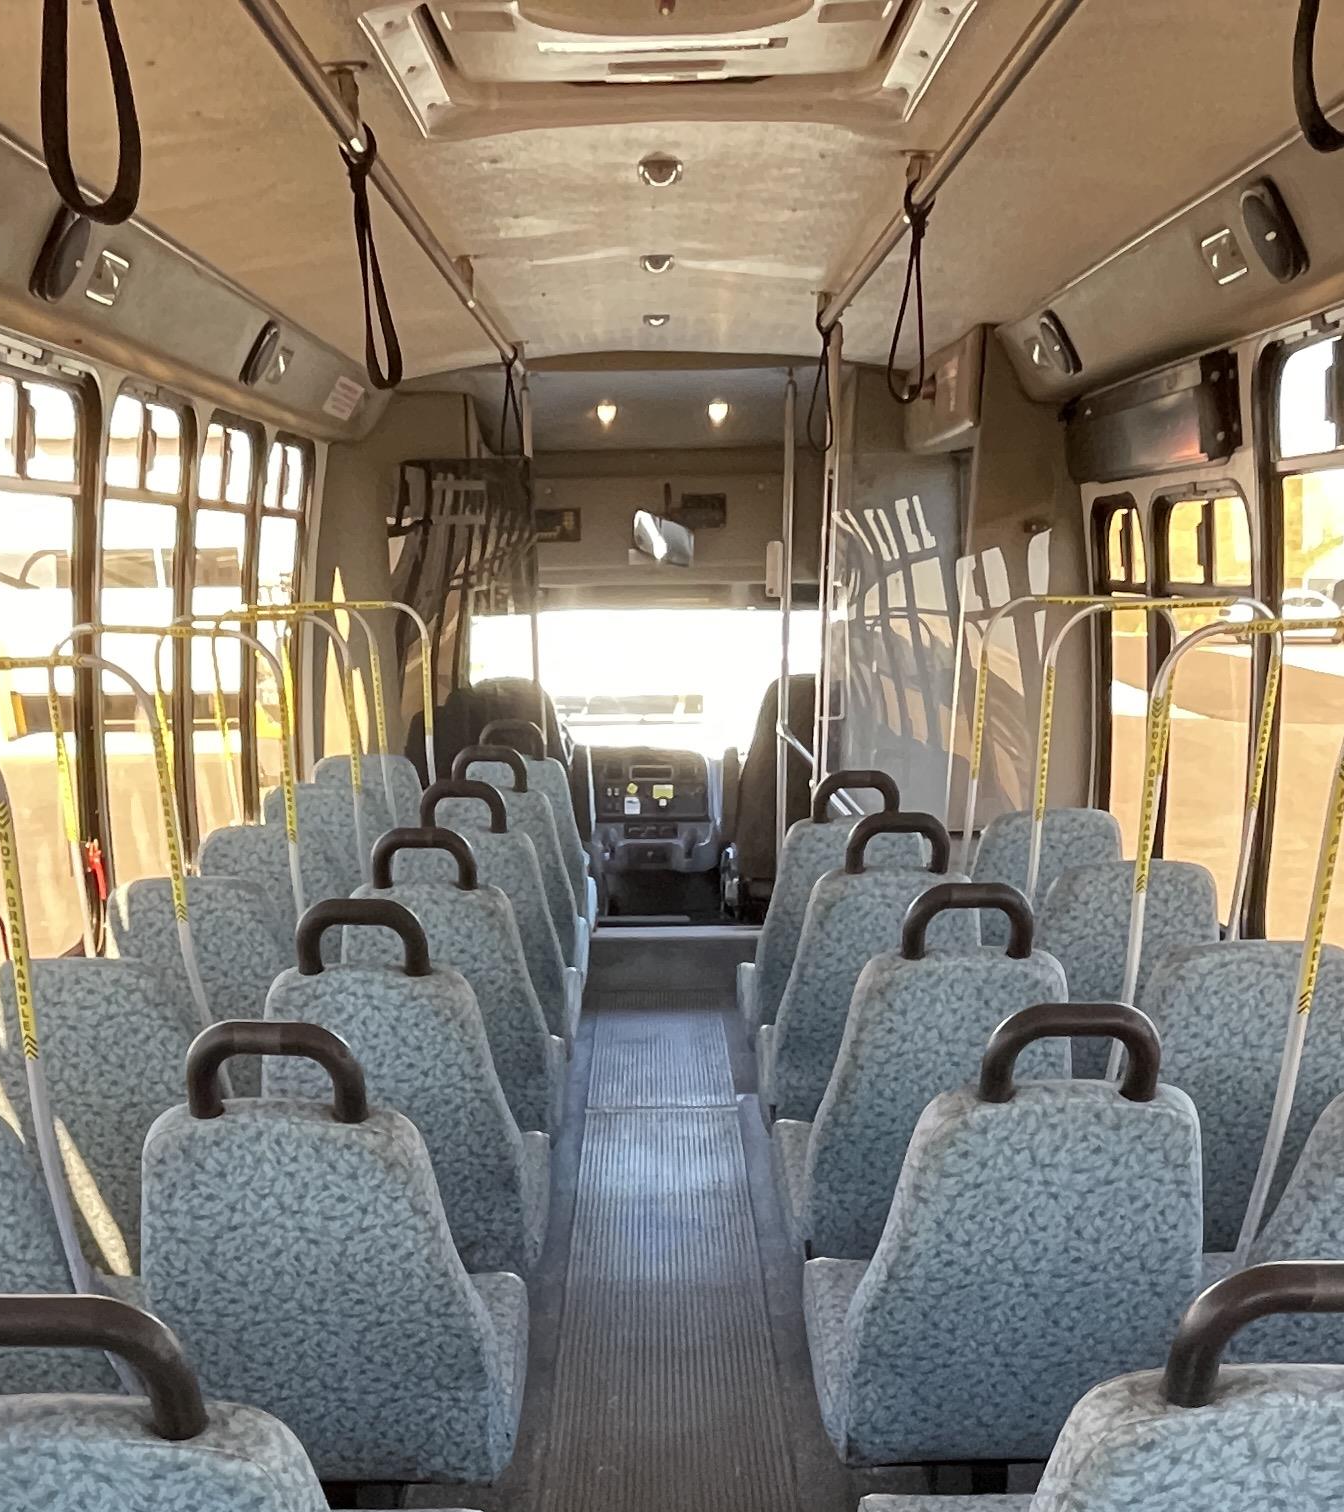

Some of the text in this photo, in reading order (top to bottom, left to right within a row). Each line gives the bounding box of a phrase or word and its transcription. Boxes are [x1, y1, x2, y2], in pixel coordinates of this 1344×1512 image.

[1247, 623, 1272, 632] NOT
[1276, 622, 1284, 631] A
[0, 831, 31, 1032] NOT A GRAB HANDLE
